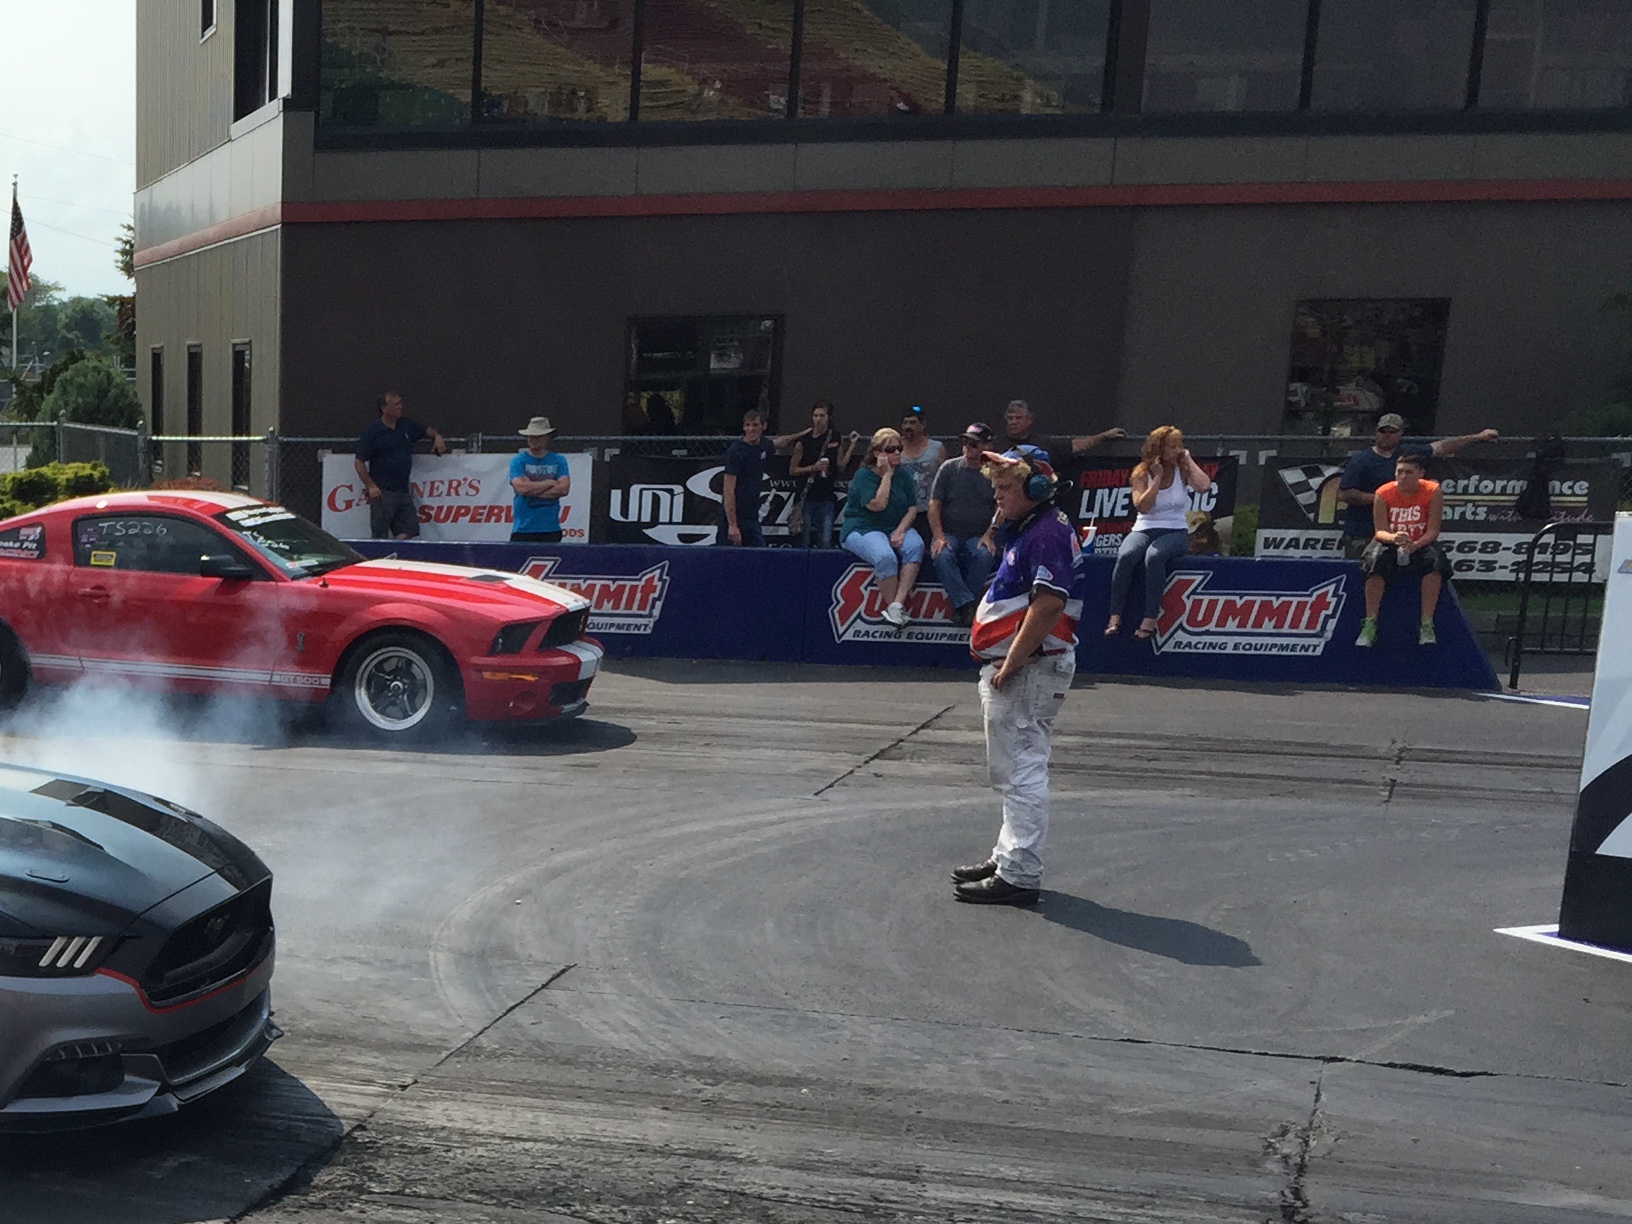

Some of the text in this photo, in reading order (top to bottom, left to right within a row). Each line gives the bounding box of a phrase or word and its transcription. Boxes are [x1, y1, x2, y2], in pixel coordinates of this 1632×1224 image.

[1441, 474, 1589, 494] erformnce
[1079, 486, 1132, 519] LIVE
[1441, 502, 1488, 521] arts
[1389, 505, 1421, 522] THIS
[1156, 578, 1332, 638] SUMMIT
[586, 621, 649, 632] QUIPMENT
[852, 629, 971, 642] RACING EQUIPME
[1173, 640, 1321, 653] RACING EQUIPMENT
